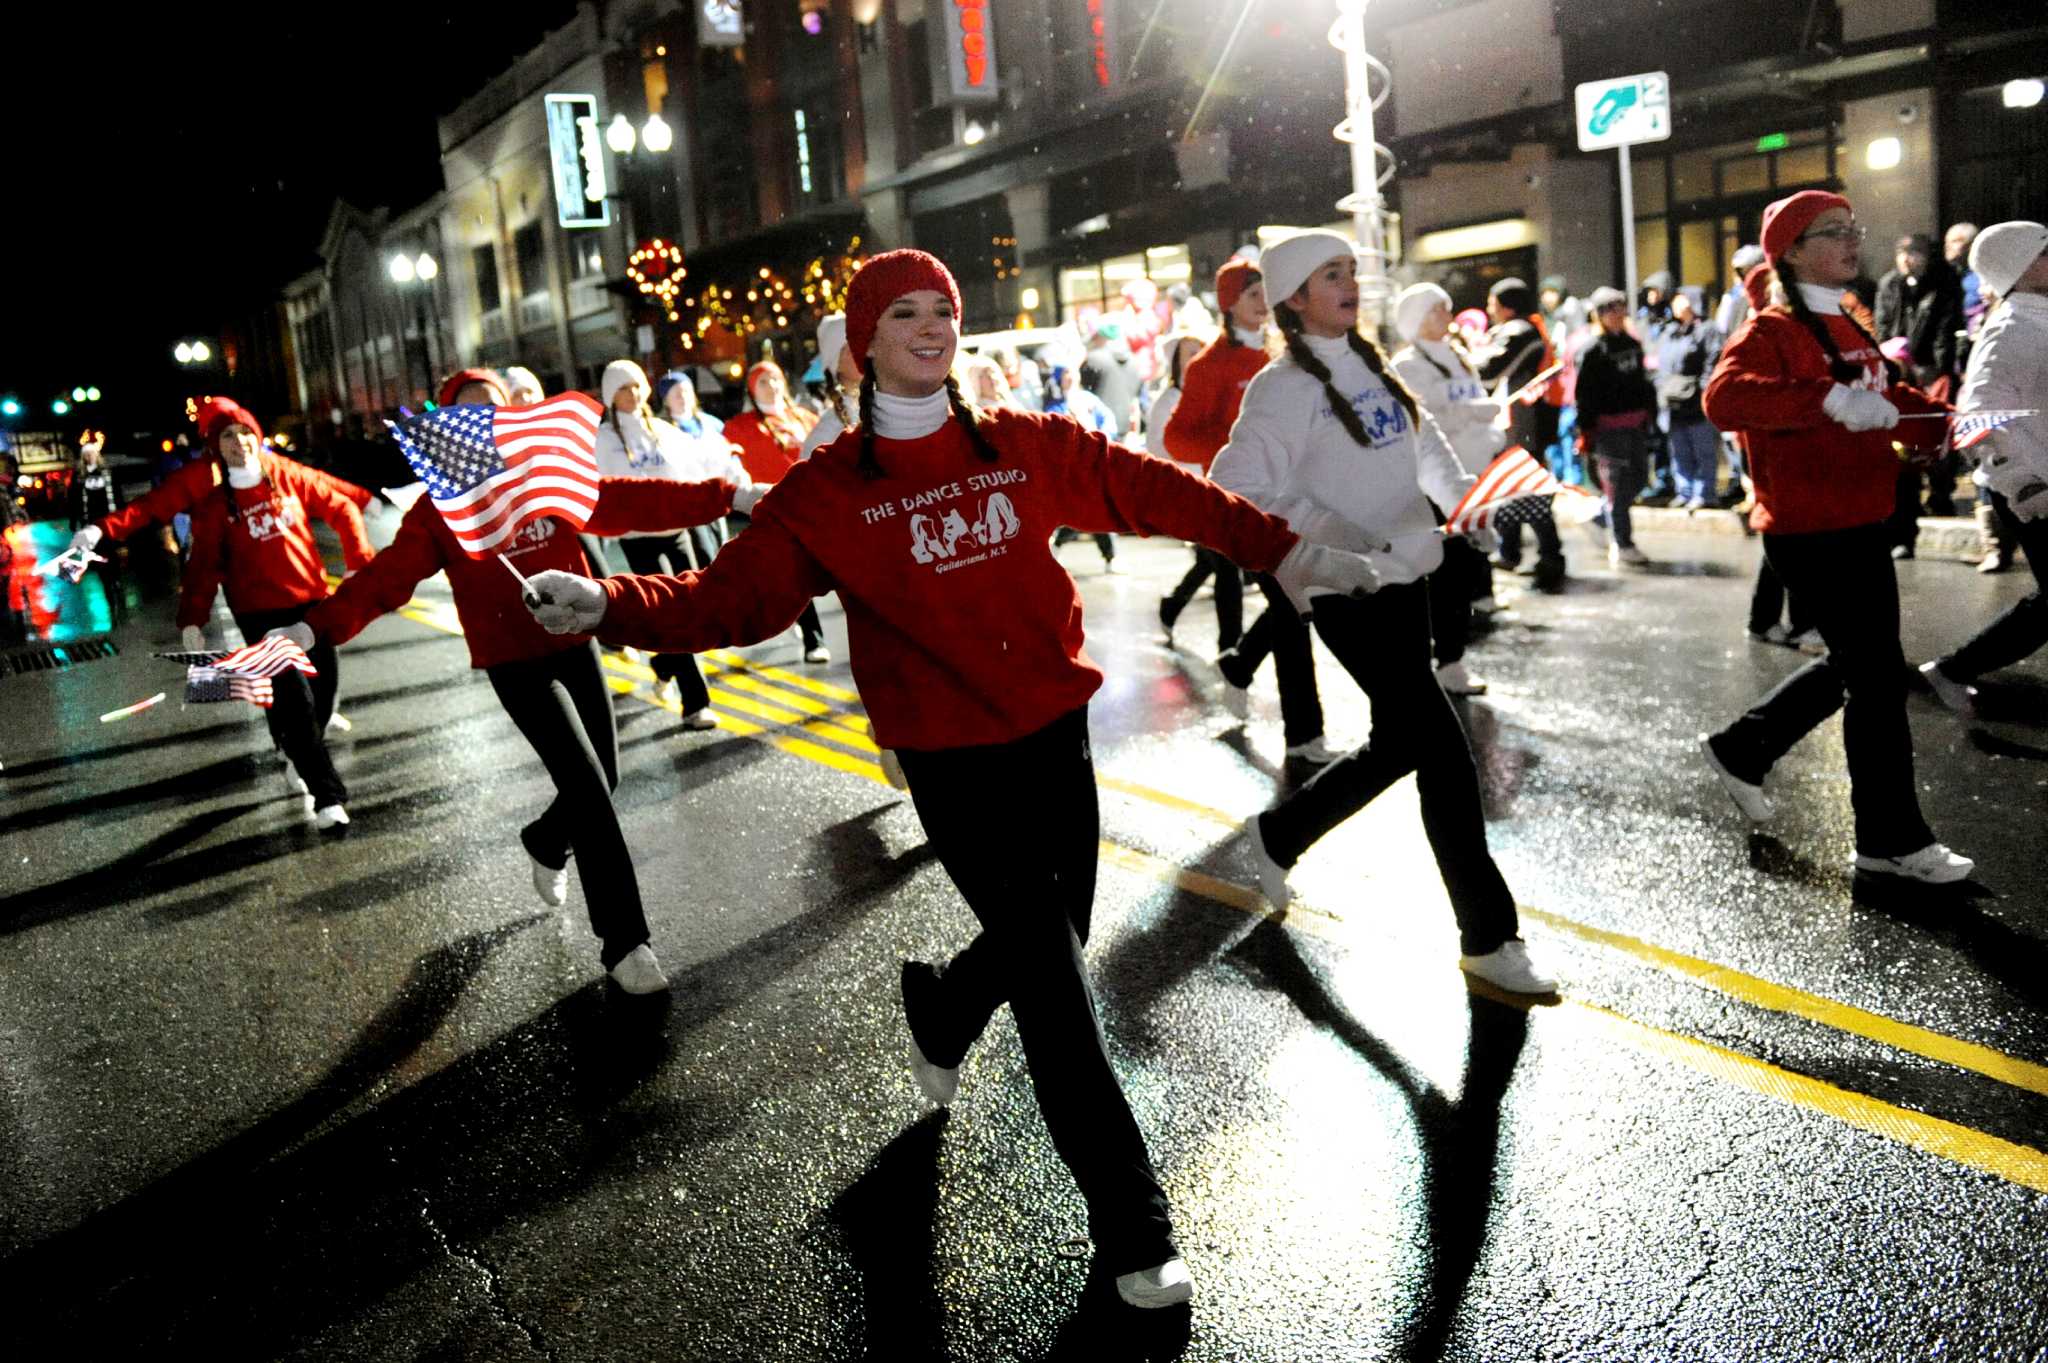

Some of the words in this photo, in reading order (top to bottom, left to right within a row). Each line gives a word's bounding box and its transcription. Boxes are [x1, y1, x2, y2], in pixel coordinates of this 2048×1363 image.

[860, 502, 897, 525] THE
[901, 482, 963, 512] DANCE
[967, 468, 1028, 492] STUDIO
